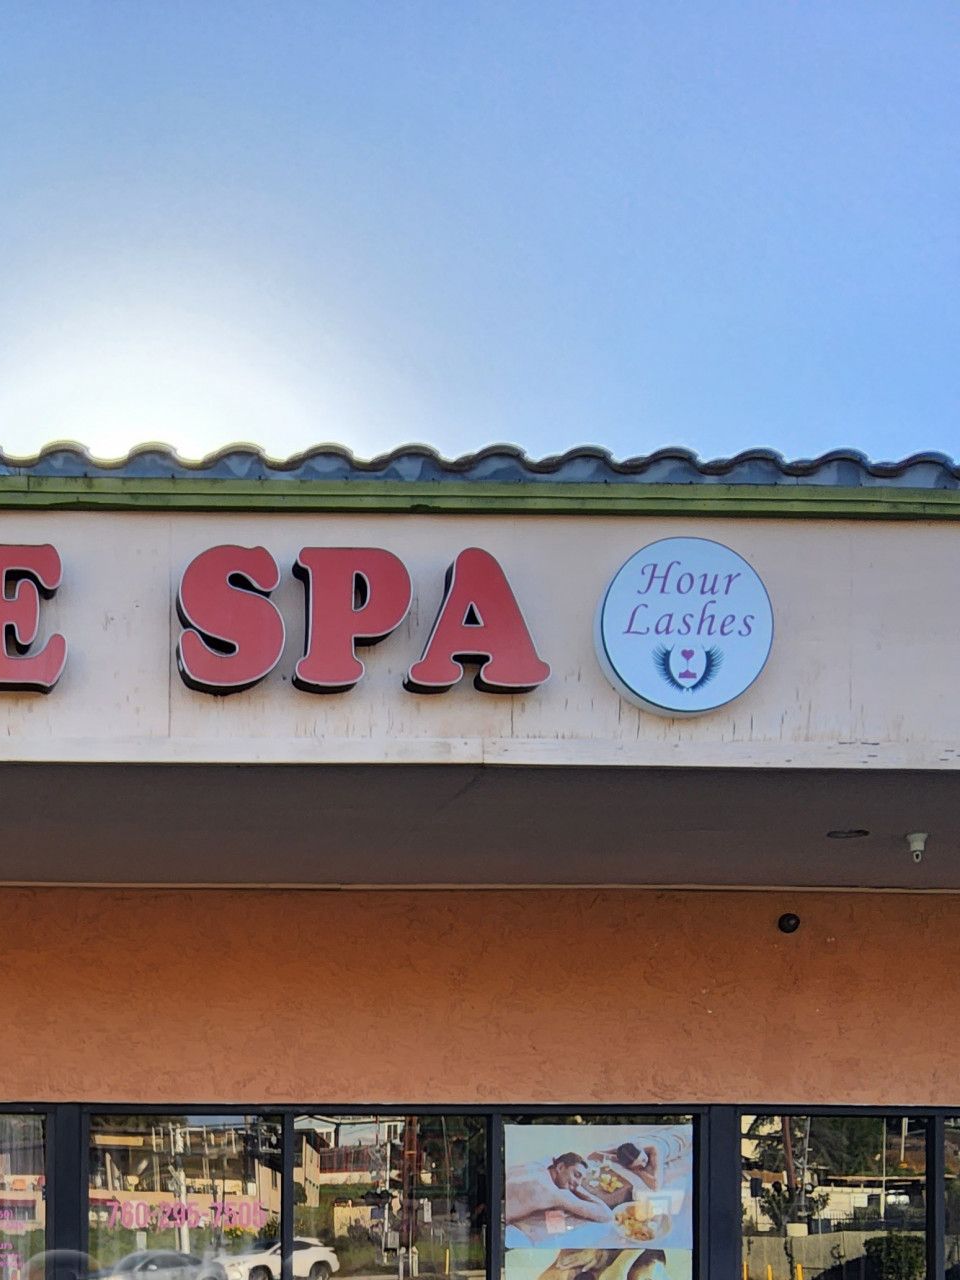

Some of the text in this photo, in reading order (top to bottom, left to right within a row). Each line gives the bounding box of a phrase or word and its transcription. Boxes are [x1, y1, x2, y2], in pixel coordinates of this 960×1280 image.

[637, 561, 741, 596] Hour
[177, 543, 552, 695] SPA
[622, 600, 755, 637] Lashes
